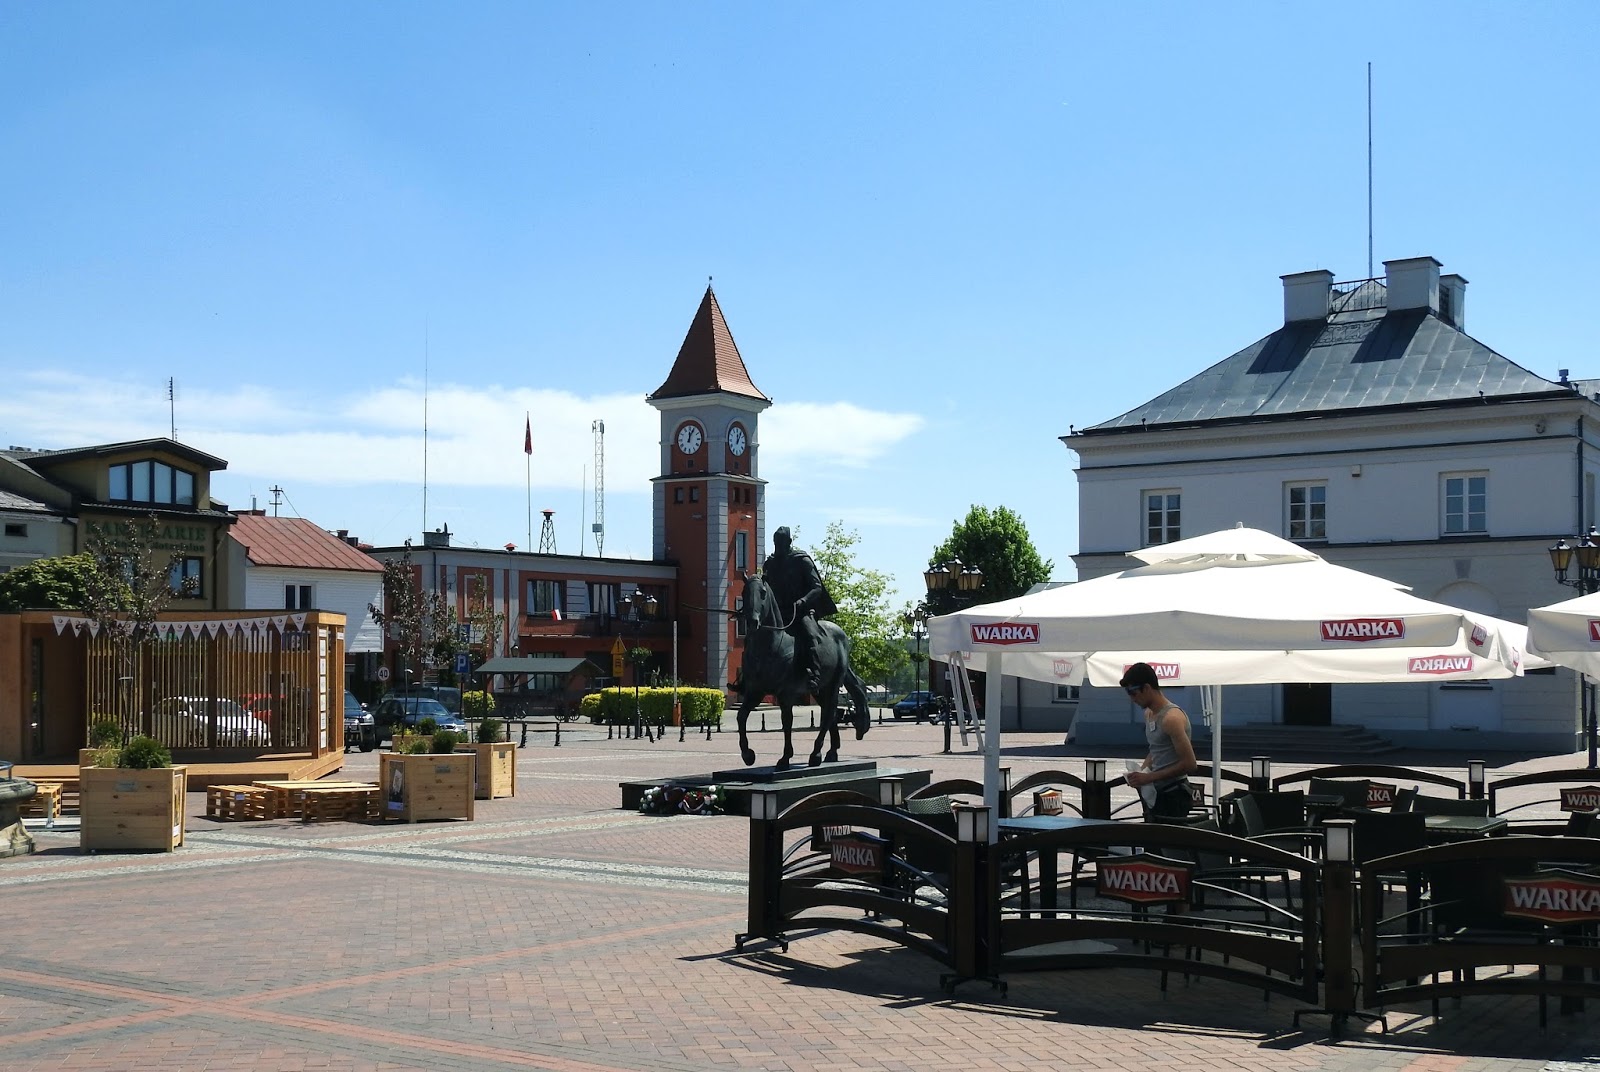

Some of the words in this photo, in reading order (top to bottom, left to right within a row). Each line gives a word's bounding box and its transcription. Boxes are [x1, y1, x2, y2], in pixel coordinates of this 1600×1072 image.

[85, 521, 206, 541] KANEARIE
[973, 626, 1036, 640] WARKA
[1325, 621, 1399, 637] WARKA
[457, 655, 467, 672] P
[380, 669, 388, 678] 40
[832, 844, 875, 867] WARKA
[1103, 868, 1180, 893] WARKA
